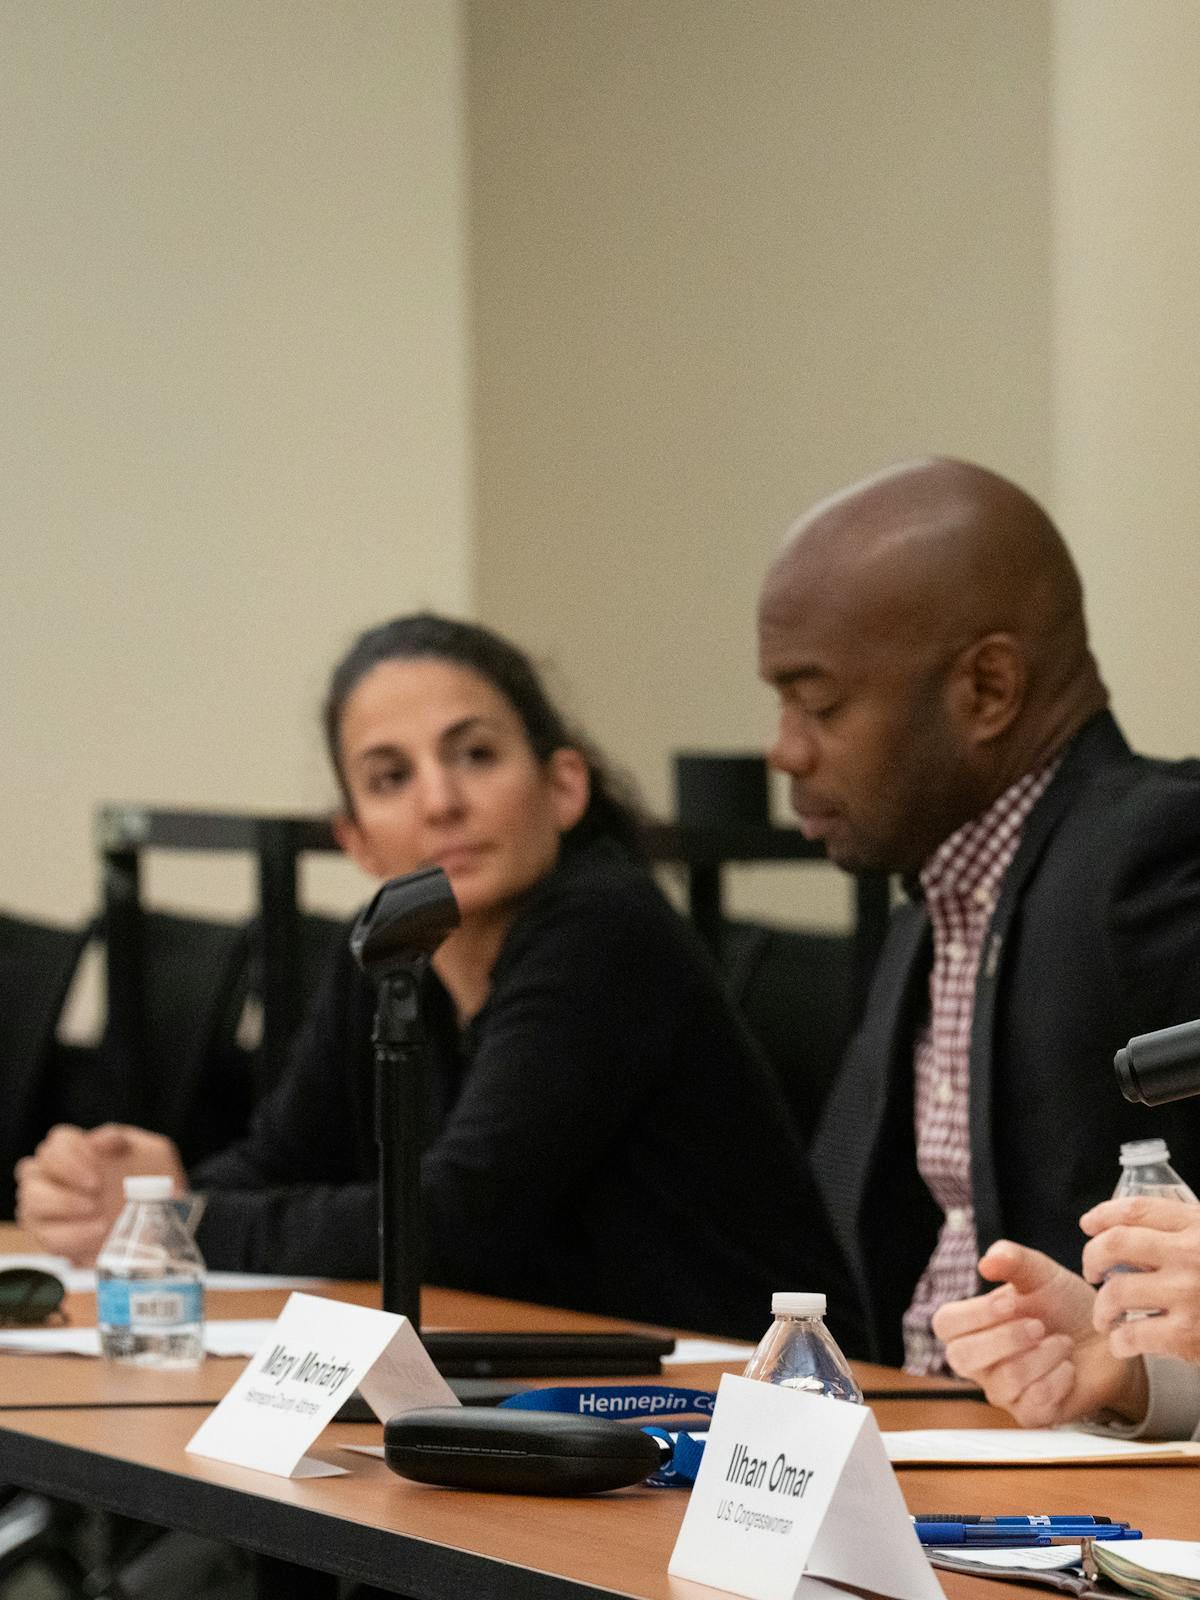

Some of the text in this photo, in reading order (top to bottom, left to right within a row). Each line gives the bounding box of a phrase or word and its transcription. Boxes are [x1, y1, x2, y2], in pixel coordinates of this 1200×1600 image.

[260, 1344, 354, 1397] Mary Moriarty
[579, 1393, 687, 1413] Hennepin
[725, 1443, 814, 1498] Ilhan Omar
